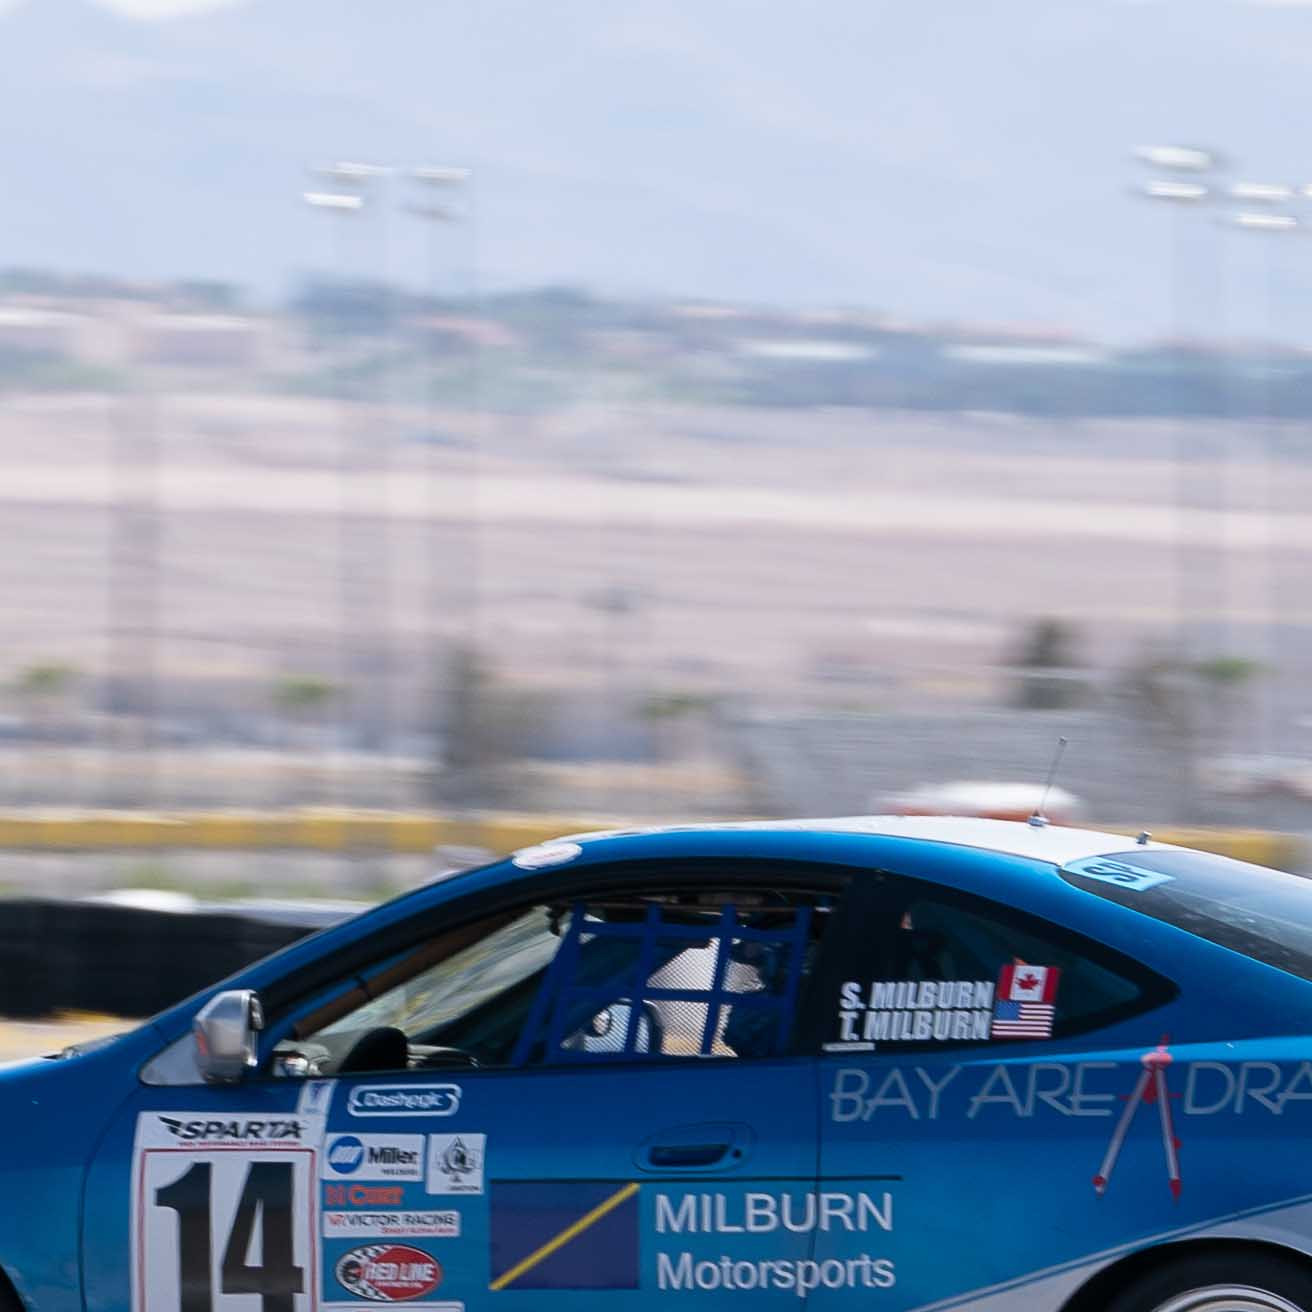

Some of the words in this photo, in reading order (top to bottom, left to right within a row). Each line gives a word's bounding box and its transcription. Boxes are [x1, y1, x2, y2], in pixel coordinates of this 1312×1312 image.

[840, 982, 866, 1010] S.
[869, 981, 995, 1010] MILBURN
[839, 1010, 860, 1041] T.
[864, 1010, 993, 1041] MILBURN
[829, 1065, 963, 1123] BAY
[176, 1119, 307, 1139] SPARTA
[368, 1147, 418, 1164] Miller
[345, 1213, 401, 1226] VICTOR
[403, 1213, 456, 1226] RACING
[656, 1192, 893, 1233] MILBURN
[365, 1262, 399, 1281] RED
[400, 1262, 434, 1281] LINE
[658, 1252, 896, 1298] Motorsports
